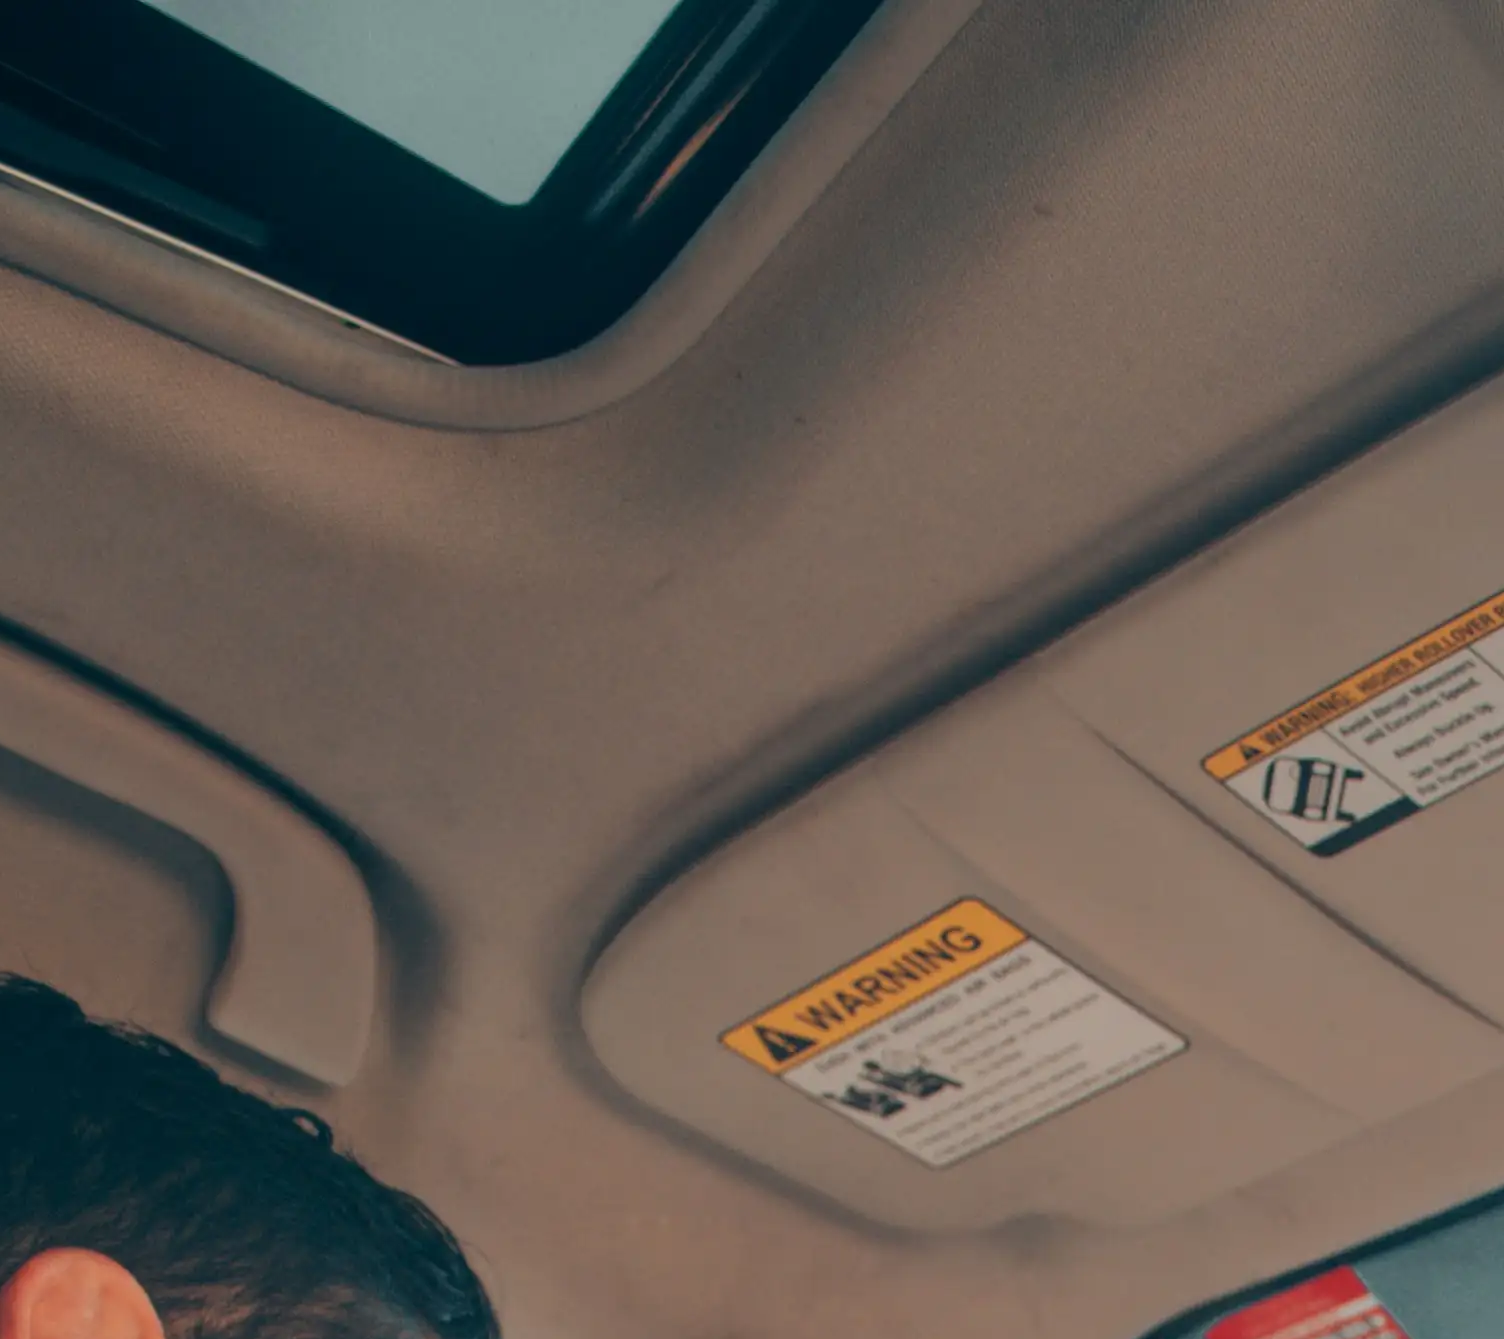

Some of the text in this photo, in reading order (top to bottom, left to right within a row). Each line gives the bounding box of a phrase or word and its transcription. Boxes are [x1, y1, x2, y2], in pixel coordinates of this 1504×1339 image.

[1261, 690, 1351, 747] WARNING:
[1356, 656, 1416, 694] HIGHER
[1412, 613, 1496, 662] ROLLOVER
[1339, 714, 1373, 736] Avoid
[1371, 693, 1411, 719] Abrupt
[1363, 728, 1386, 745] and
[1383, 698, 1442, 733] Excessive
[1393, 733, 1436, 759] Always
[1433, 712, 1476, 737] Buckle
[794, 925, 983, 1032] WARNING
